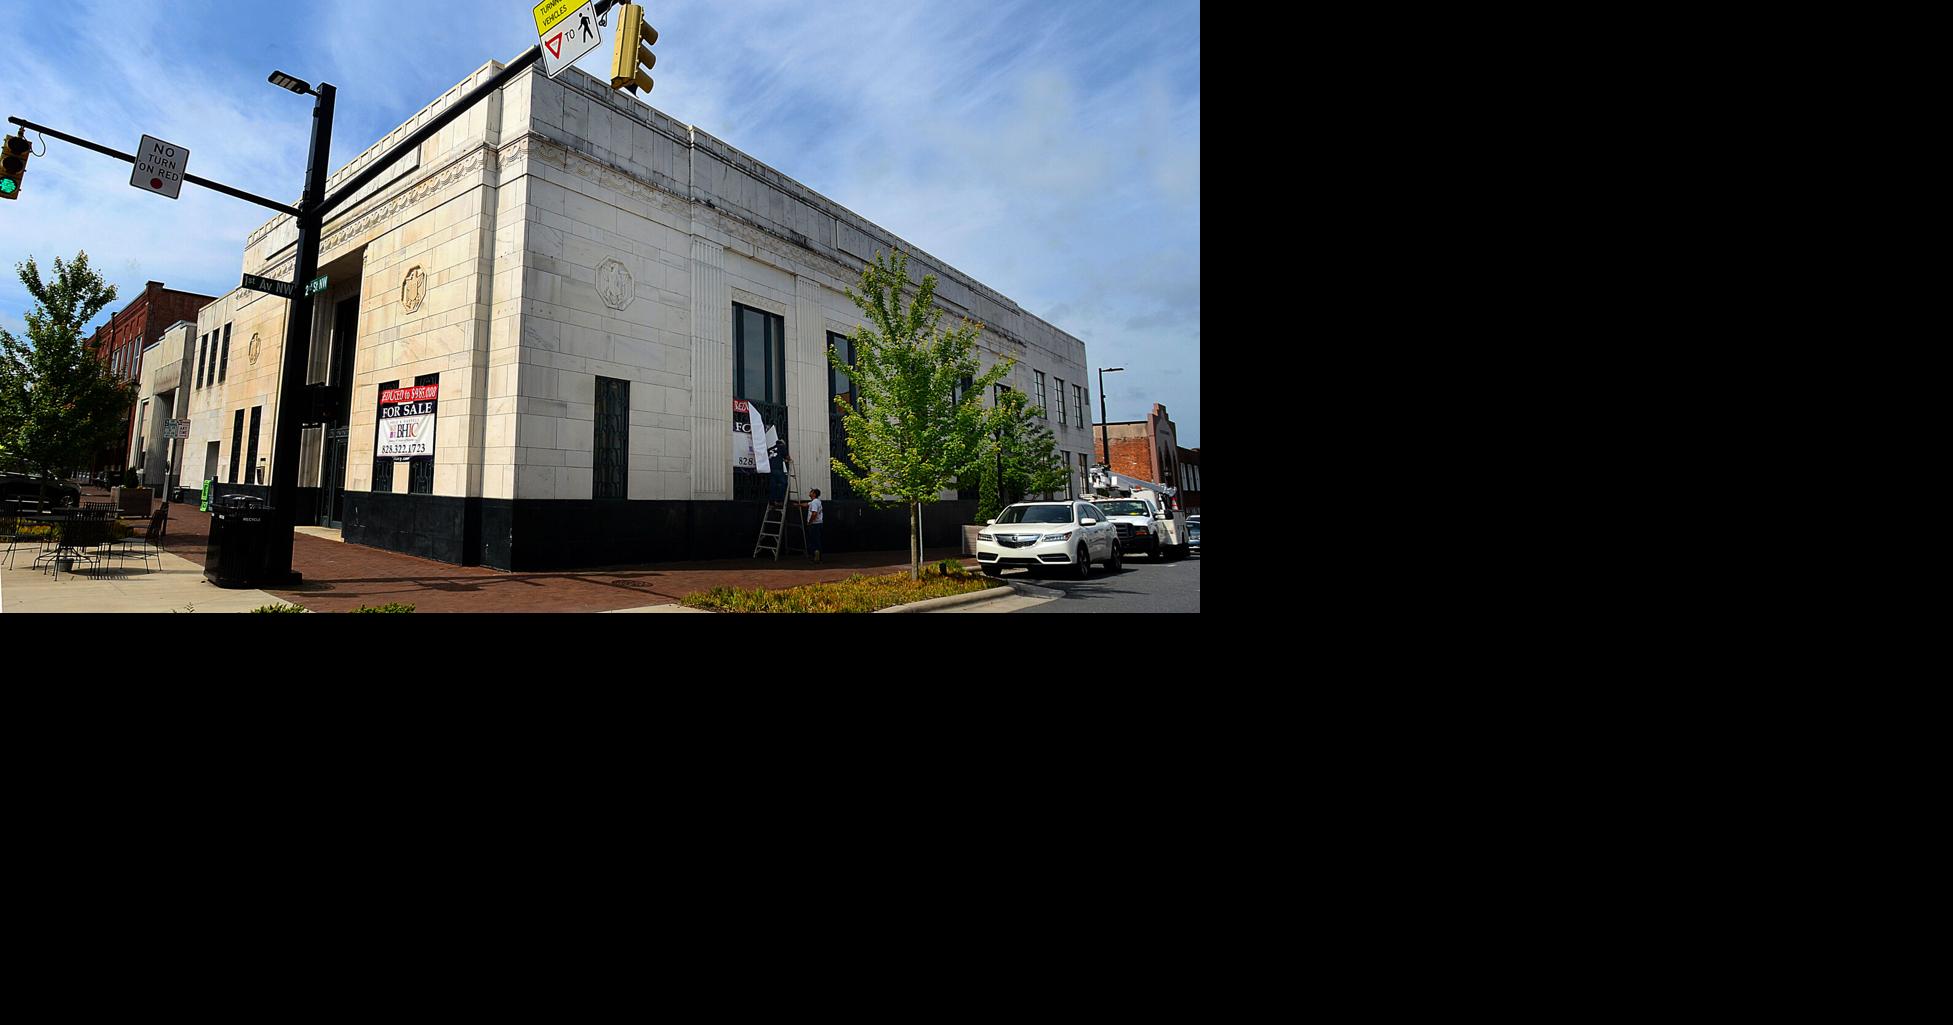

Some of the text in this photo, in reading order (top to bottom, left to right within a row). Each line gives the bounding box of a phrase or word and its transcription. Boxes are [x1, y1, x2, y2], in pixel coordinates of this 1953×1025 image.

[542, 4, 568, 27] VEHICLES
[564, 29, 576, 42] TO
[154, 143, 175, 157] NO
[148, 153, 176, 170] TURN
[139, 162, 179, 181] ON RED
[244, 275, 294, 296] 1st Av NW
[319, 275, 328, 290] NW
[382, 402, 433, 418] FOR SALE
[735, 421, 752, 433] FO
[381, 443, 426, 454] 828.322.1723
